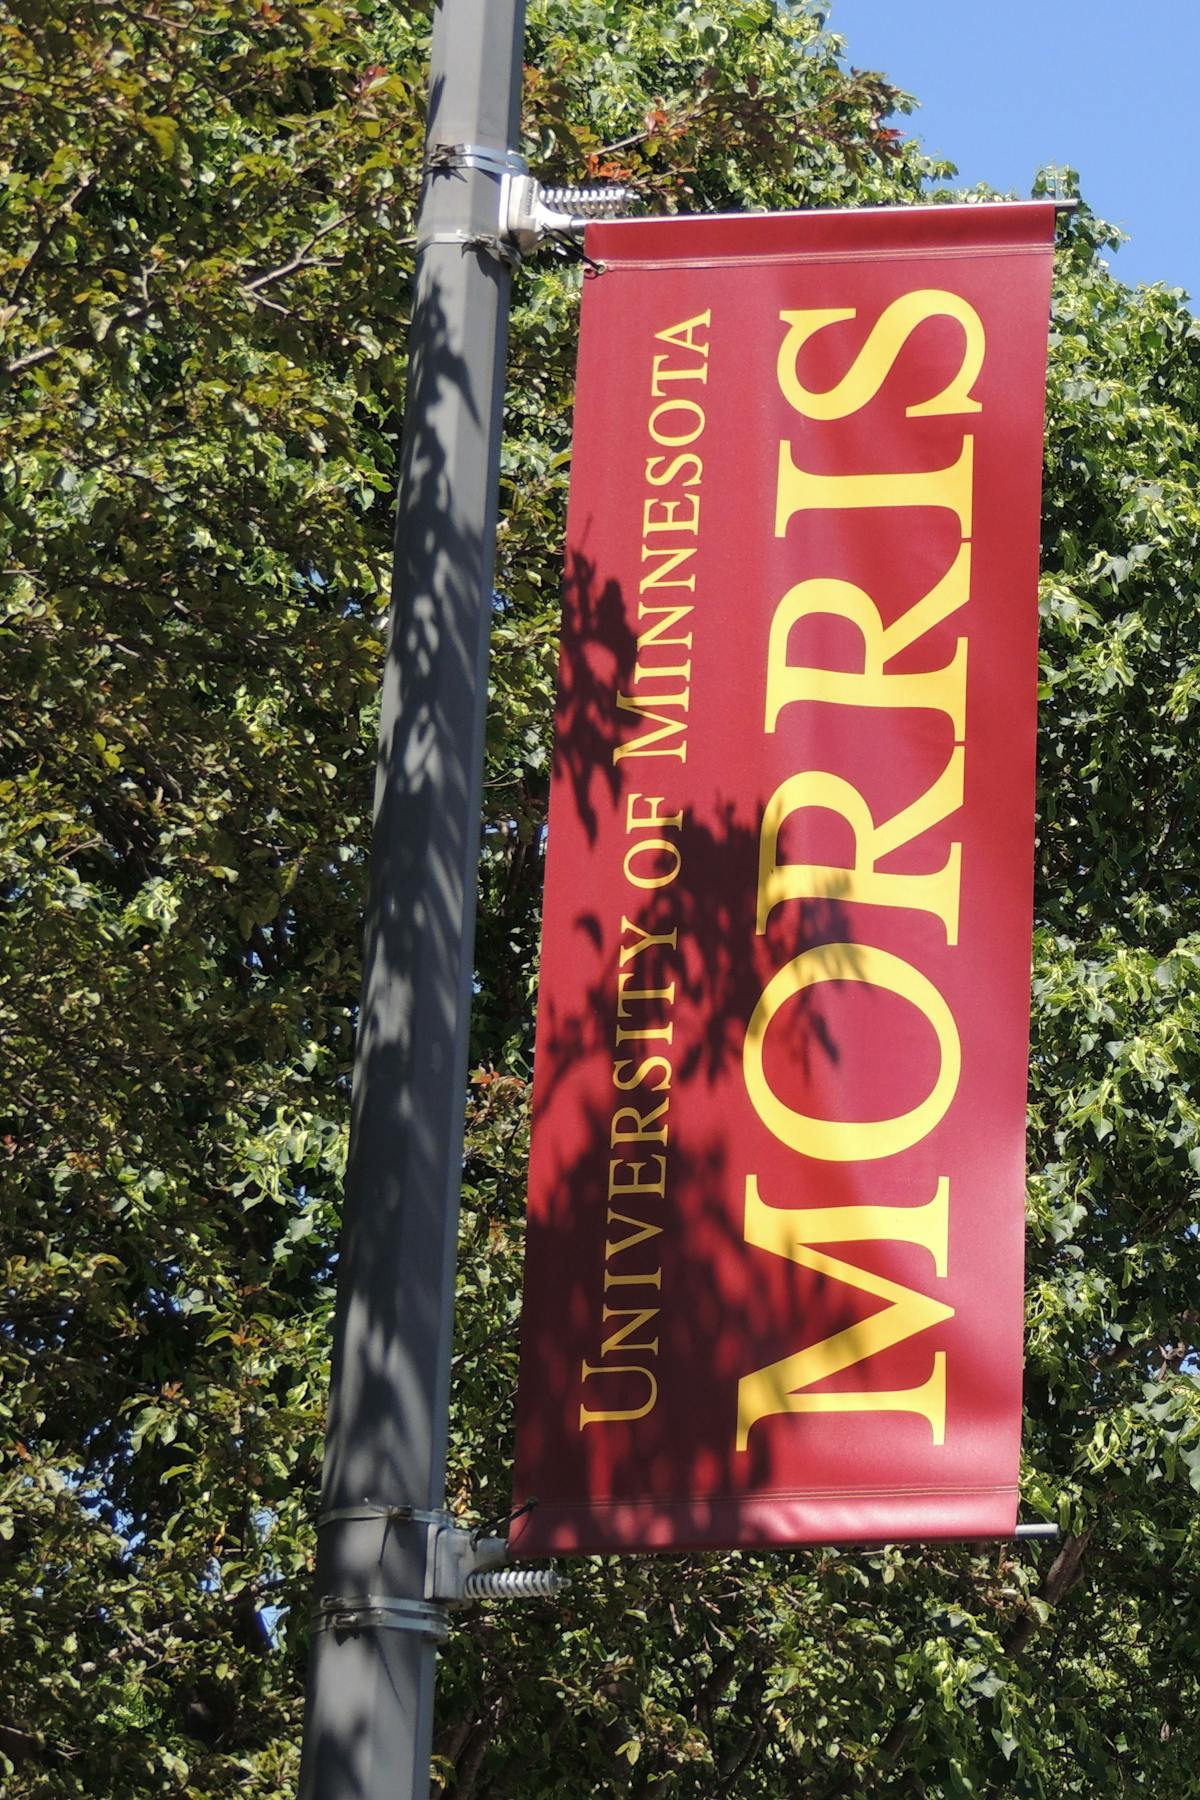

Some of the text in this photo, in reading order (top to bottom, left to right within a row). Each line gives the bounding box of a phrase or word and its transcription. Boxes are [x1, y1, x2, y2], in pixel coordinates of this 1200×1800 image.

[579, 309, 711, 1431] UNIVERSITY OF MINNESOTA
[737, 289, 986, 1451] MORRIS
